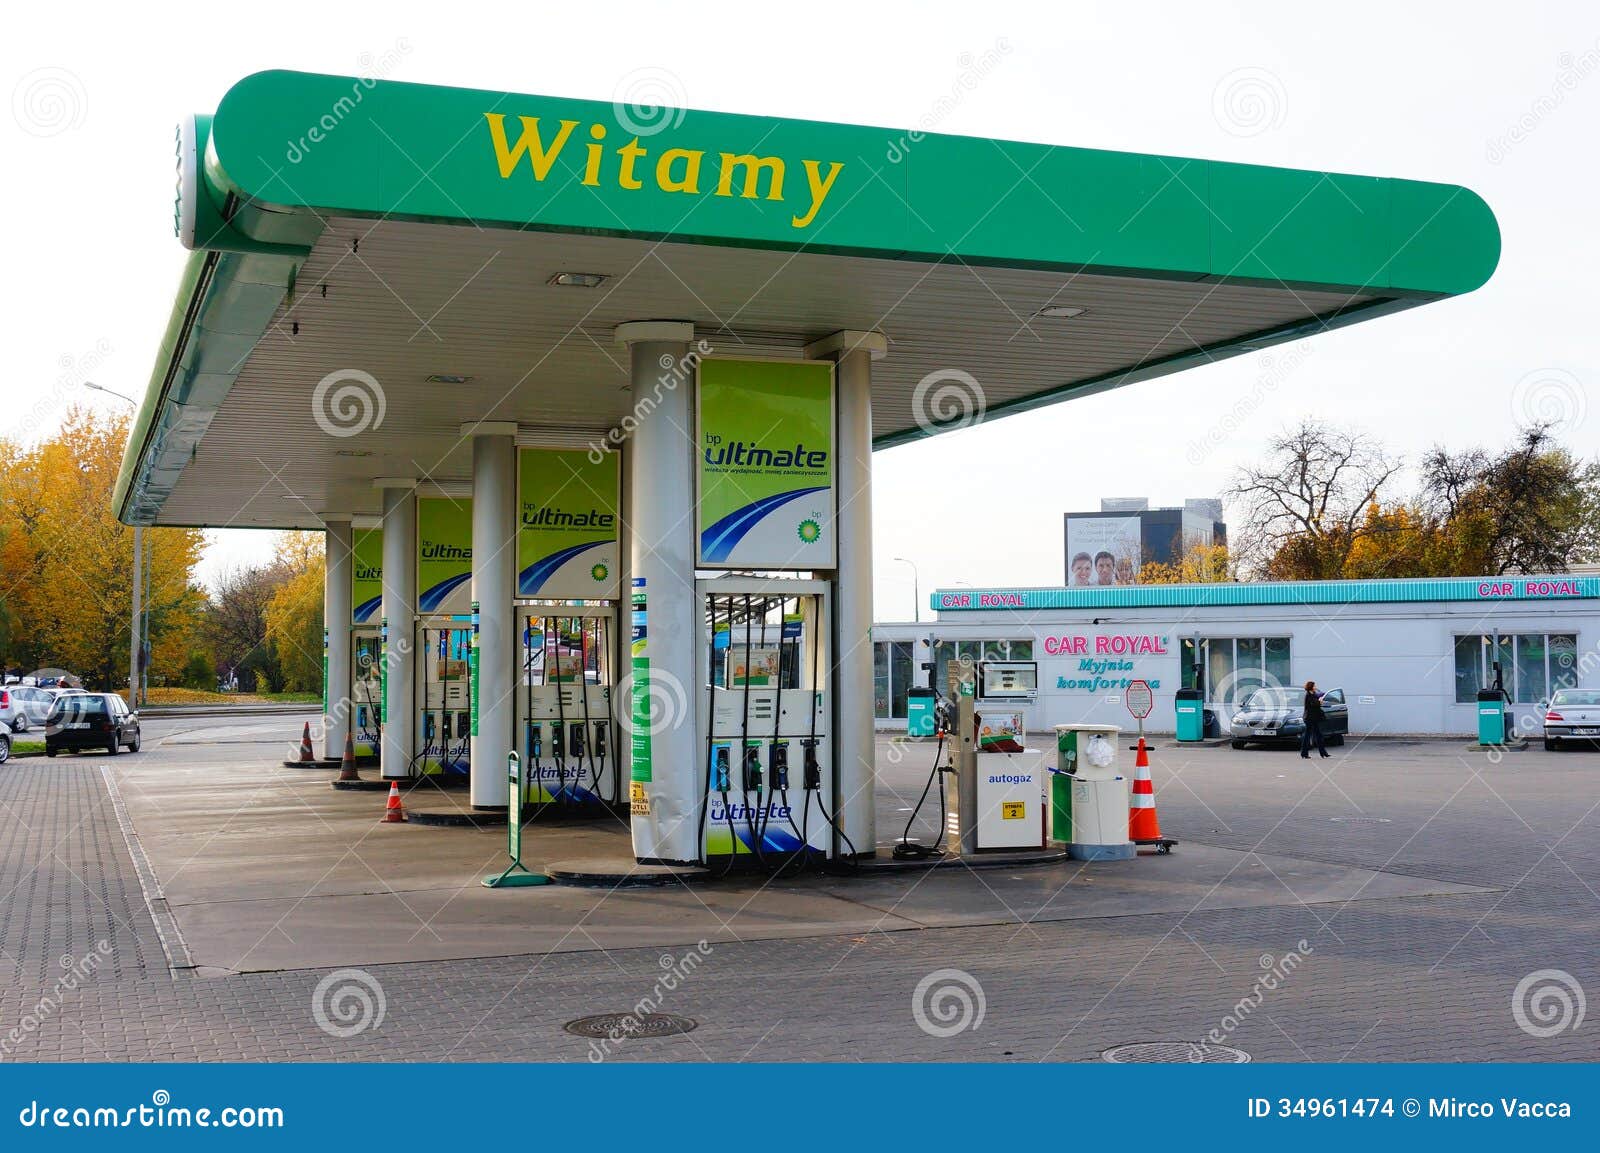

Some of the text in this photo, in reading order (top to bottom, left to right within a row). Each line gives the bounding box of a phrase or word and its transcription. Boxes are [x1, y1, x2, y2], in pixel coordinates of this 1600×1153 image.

[482, 112, 845, 229] Witamy
[706, 431, 722, 447] bp
[704, 441, 828, 468] ultimate
[523, 500, 536, 511] bp
[522, 507, 614, 527] ultimate
[811, 510, 822, 519] bp
[1478, 581, 1581, 597] CAR ROYAL
[941, 593, 1025, 607] CAR ROYAL
[1044, 635, 1168, 656] CAR ROYAL
[1077, 657, 1134, 675] Myjnia
[1056, 676, 1161, 693] komfortoa
[988, 773, 1032, 785] autogaz
[1010, 809, 1017, 817] 2
